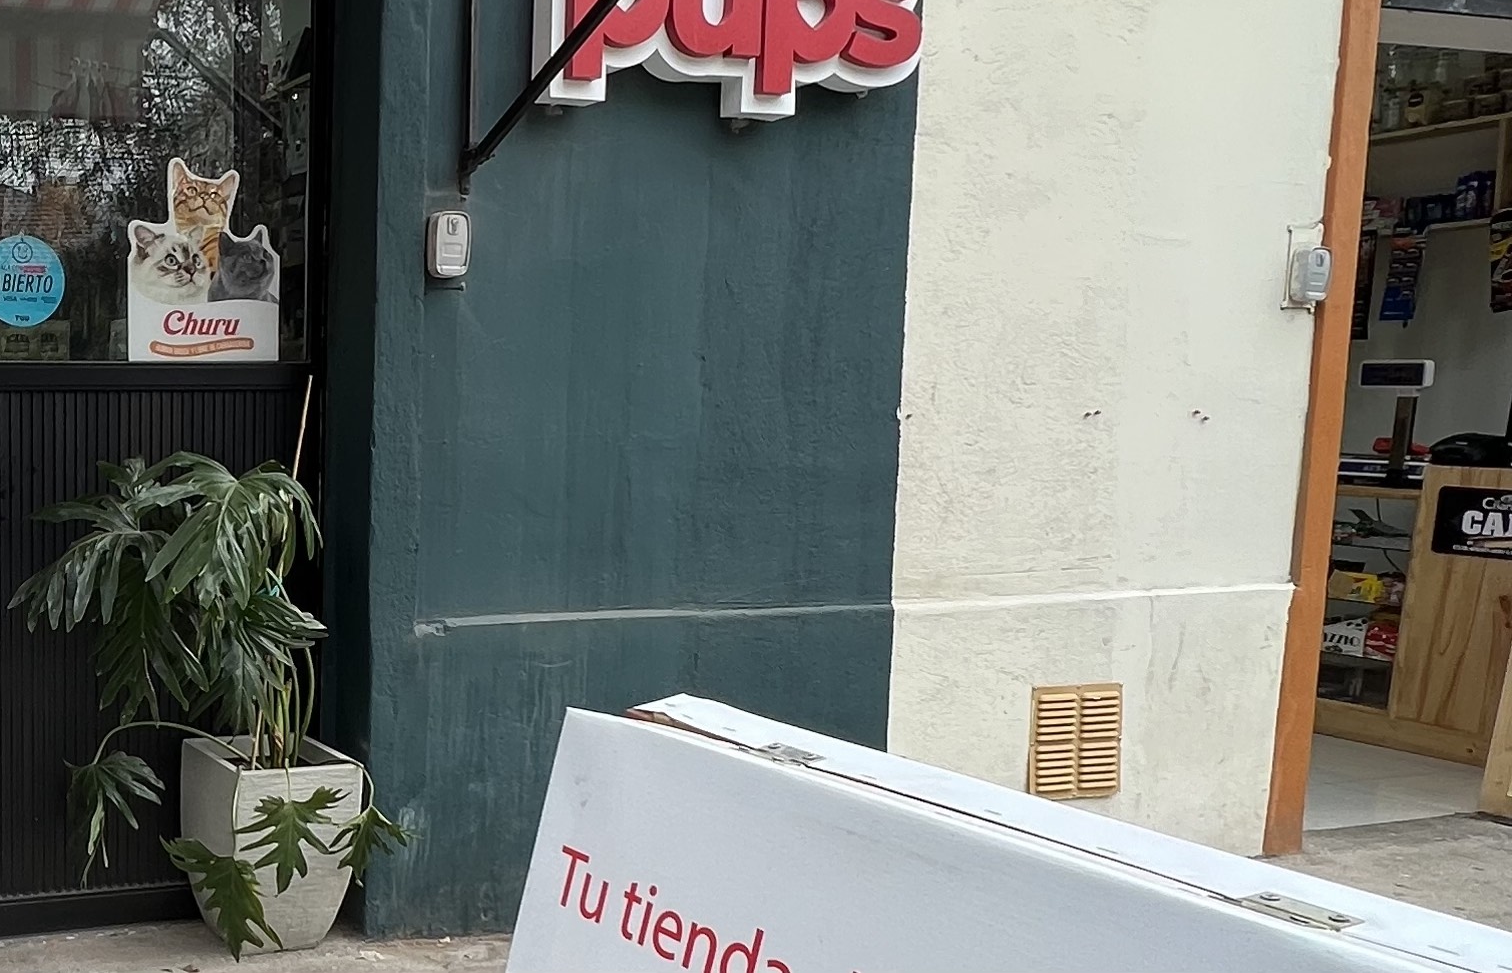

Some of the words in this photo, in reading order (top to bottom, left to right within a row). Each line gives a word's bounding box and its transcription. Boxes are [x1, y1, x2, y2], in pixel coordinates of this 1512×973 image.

[163, 310, 241, 336] Churu
[559, 844, 610, 925] Tu
[619, 882, 791, 973] tiend
